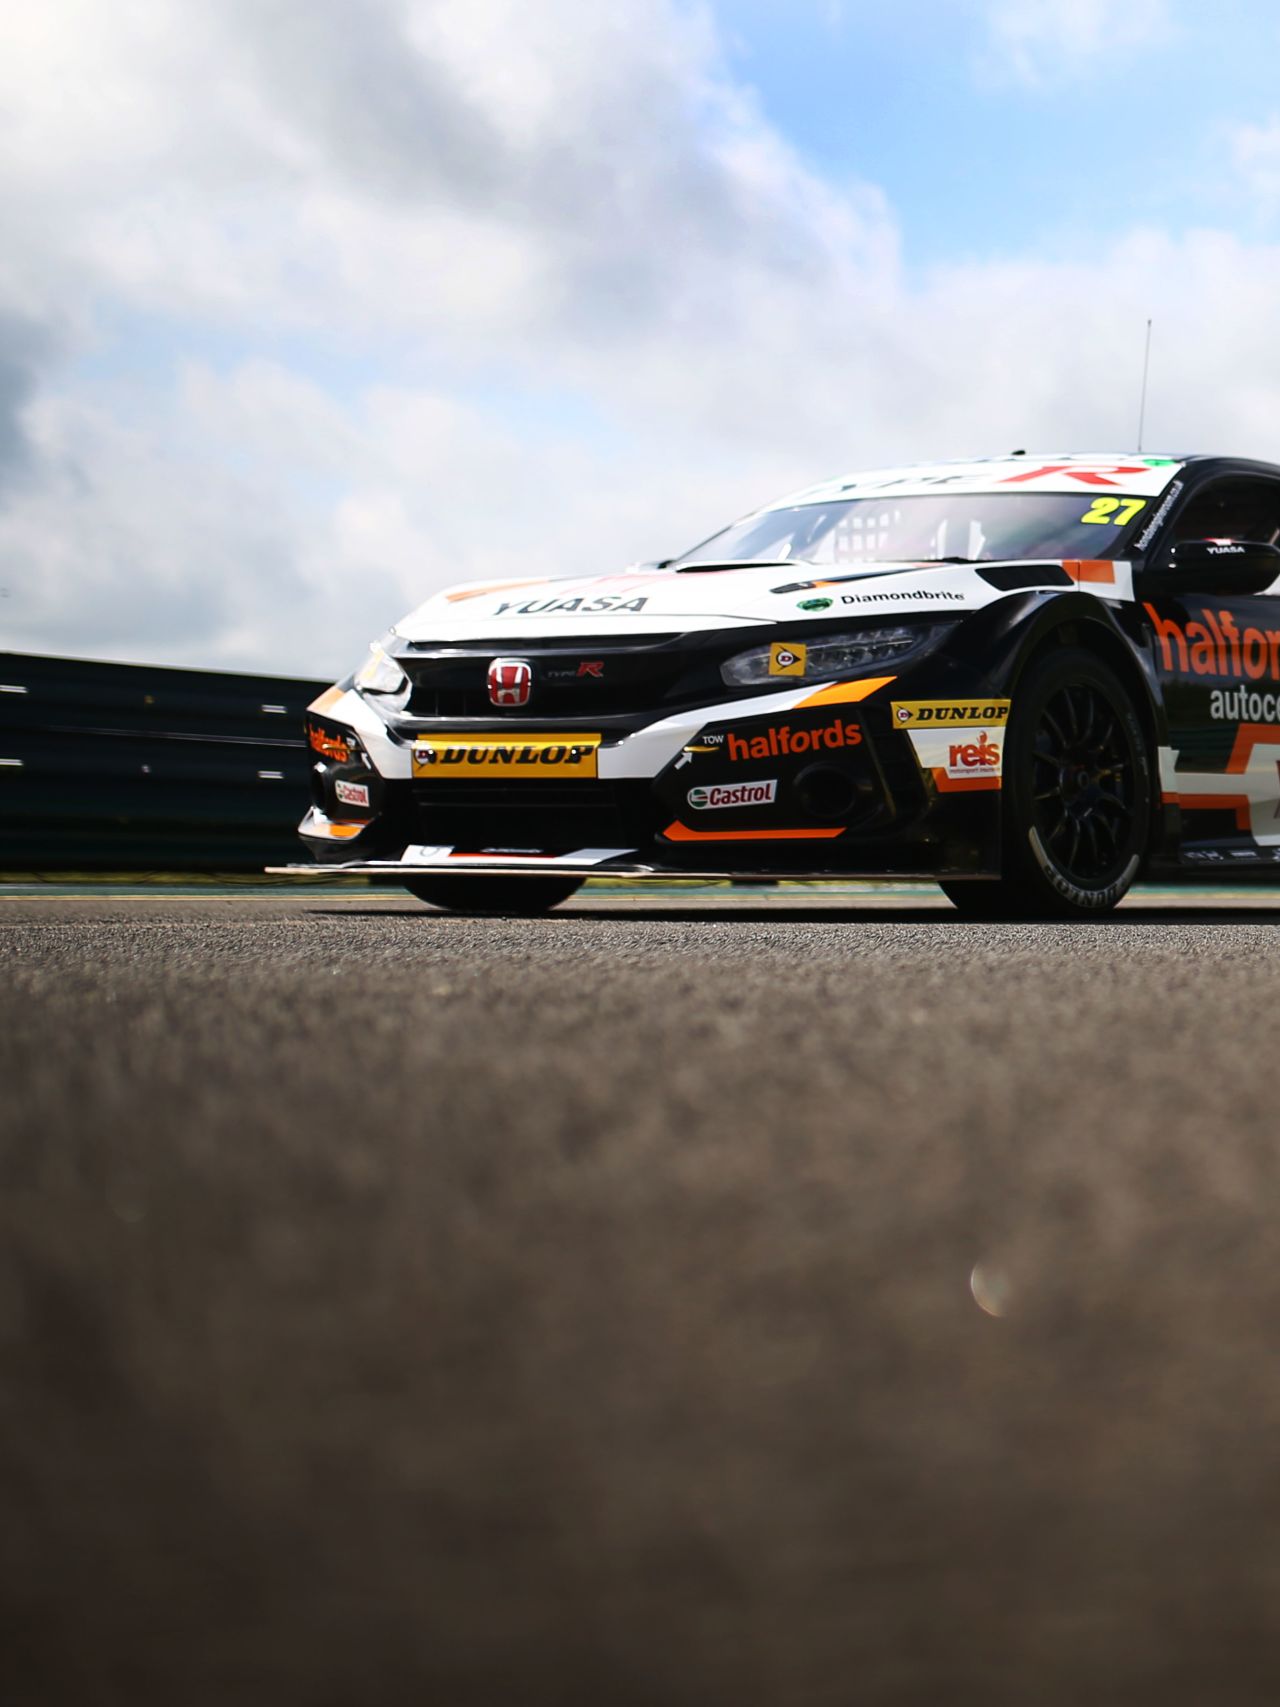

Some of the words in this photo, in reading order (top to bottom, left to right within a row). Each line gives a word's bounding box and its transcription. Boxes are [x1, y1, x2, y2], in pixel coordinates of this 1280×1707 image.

[1081, 498, 1146, 525] 27
[1206, 546, 1245, 554] YUASA
[494, 597, 648, 615] YUASA
[841, 591, 965, 605] Diamondbrite
[916, 707, 1009, 721] DUNLOP
[703, 735, 724, 744] TOW
[727, 720, 862, 761] halfords
[440, 745, 593, 765] DUNLOP
[948, 743, 1000, 767] reis
[709, 783, 771, 805] Castrol
